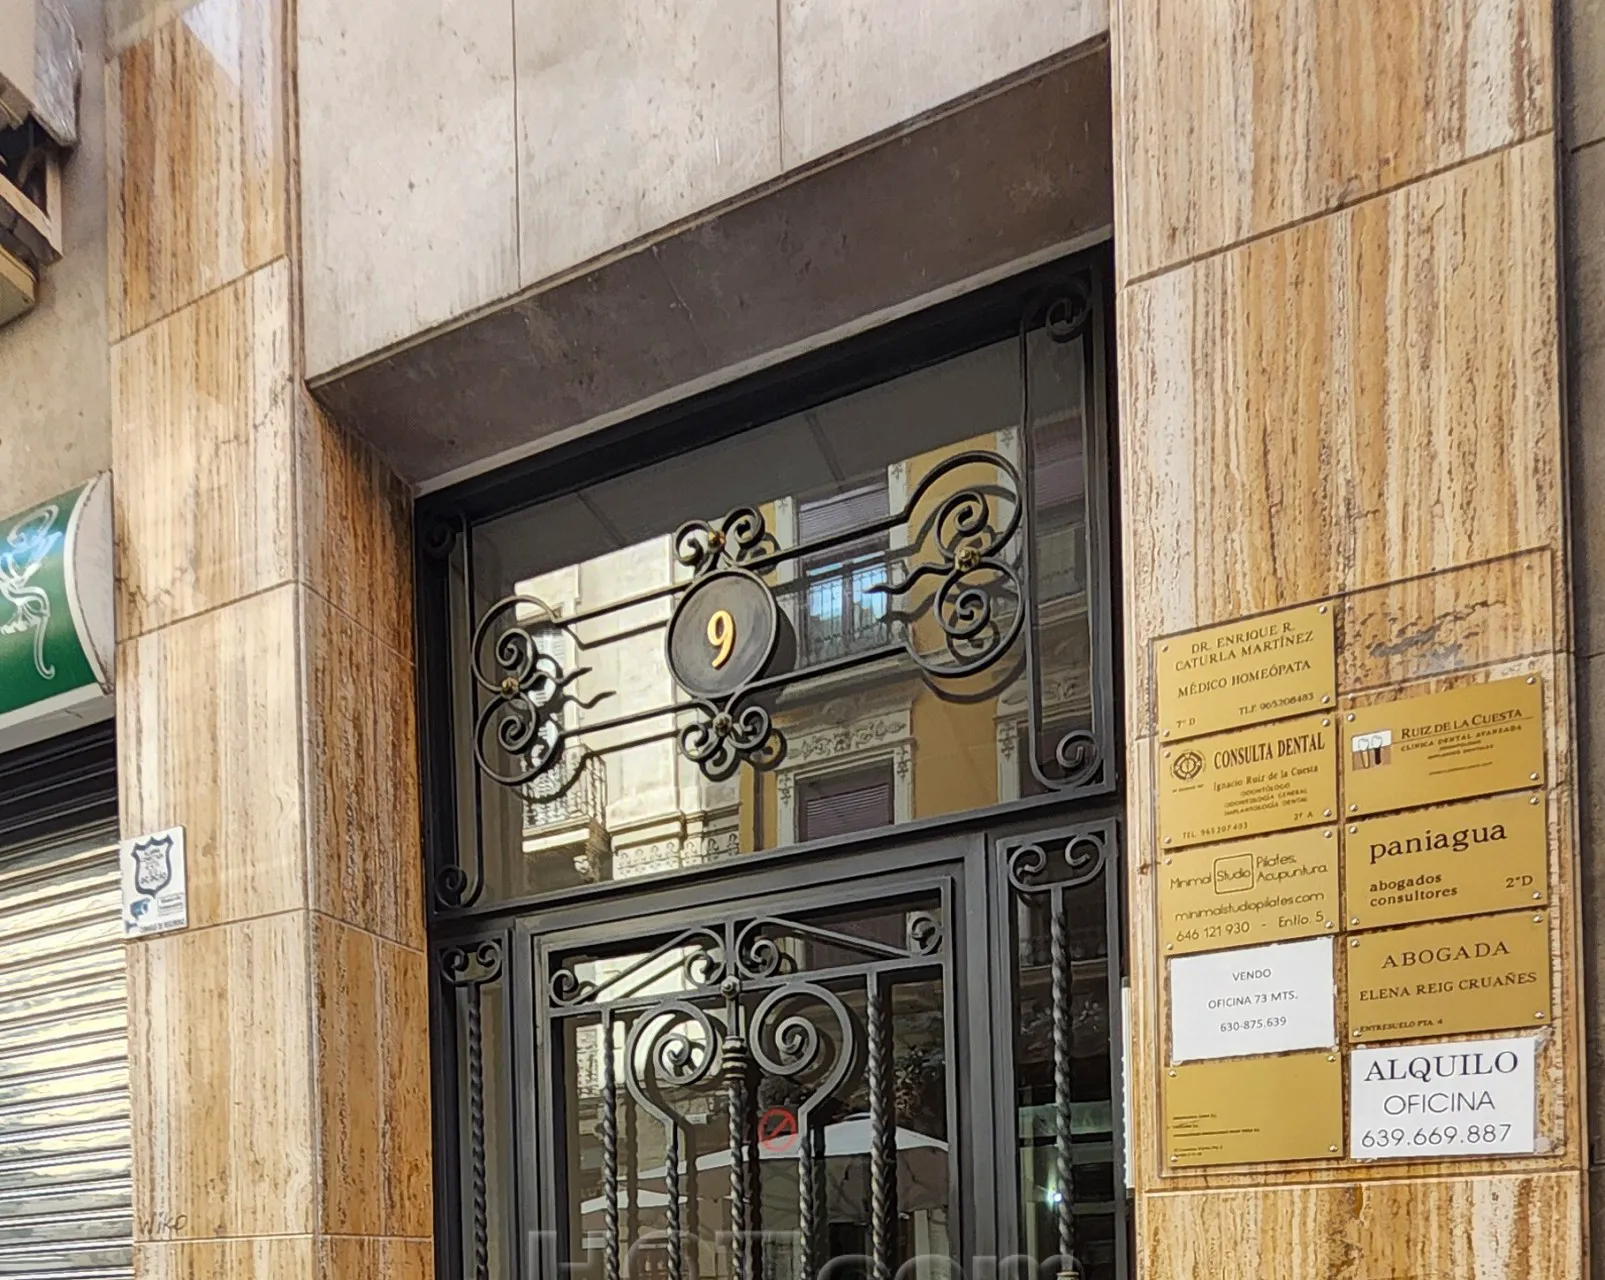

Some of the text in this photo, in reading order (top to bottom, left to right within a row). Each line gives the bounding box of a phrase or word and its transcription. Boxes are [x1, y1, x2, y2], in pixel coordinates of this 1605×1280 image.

[706, 610, 735, 671] 9
[1216, 625, 1278, 648] ENRIQUE
[1175, 630, 1314, 671] CATURLA MARTÍNEZ
[1177, 659, 1312, 698] MÉDICO HOMEÓPATA
[1214, 732, 1325, 770] CONSULTA DENTAL
[1268, 771, 1278, 781] de
[1369, 823, 1508, 865] paniagua
[1217, 868, 1251, 882] Studio
[1256, 864, 1328, 883] Acupuntura
[1369, 873, 1442, 892] abogados
[1370, 886, 1458, 907] consultores
[1176, 929, 1200, 942] 646
[1203, 925, 1222, 939] 121
[1225, 921, 1250, 935] 930
[1315, 911, 1325, 923] 5
[1381, 940, 1510, 969] ABOGADA
[1232, 968, 1272, 982] VENDO
[1359, 972, 1537, 1001] ELENA REIG CRUAÑES
[1208, 990, 1298, 1010] OFICINA 73 MTS.
[1359, 1021, 1416, 1033] ENTRESUELO
[1364, 1051, 1518, 1083] ALQUILO
[1384, 1090, 1495, 1115] OFICINA
[1361, 1123, 1512, 1148] 639.669.887
